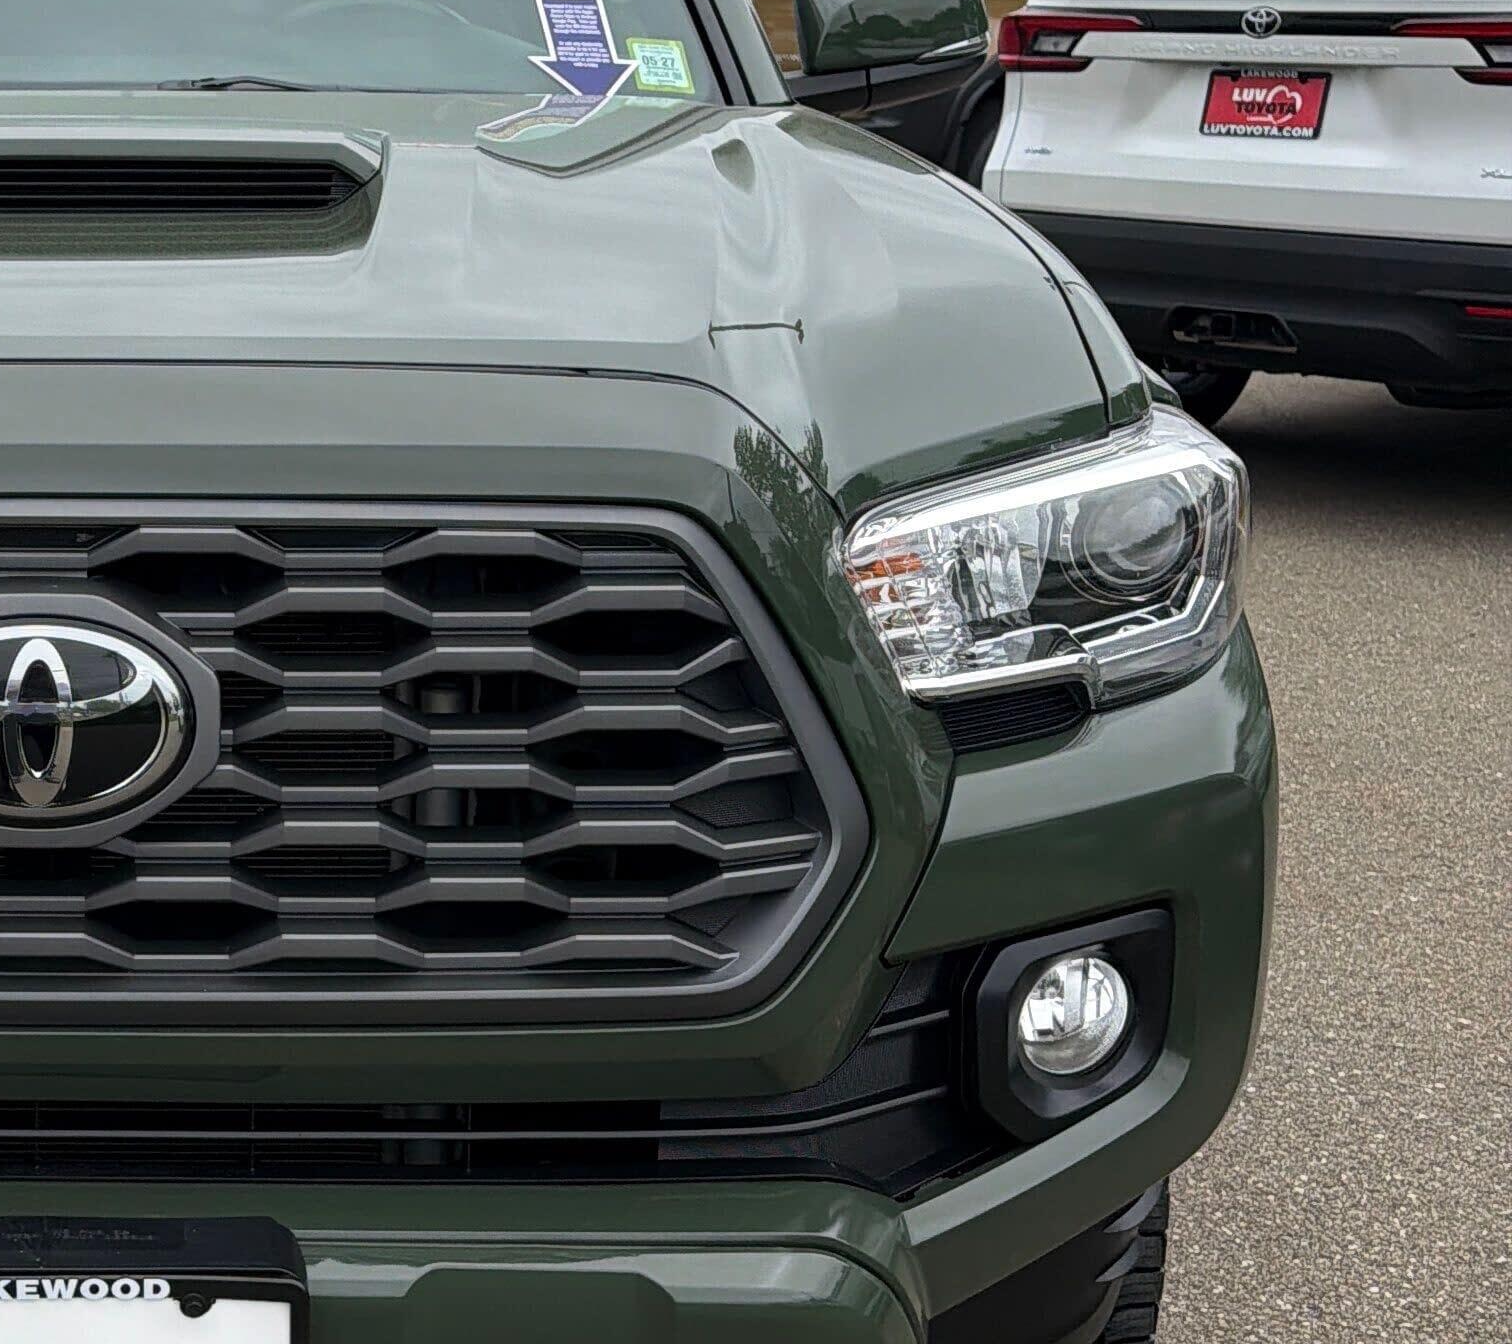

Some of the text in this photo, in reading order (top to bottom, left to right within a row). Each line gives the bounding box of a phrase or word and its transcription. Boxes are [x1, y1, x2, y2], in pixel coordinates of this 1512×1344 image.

[1240, 69, 1299, 79] LAKEWOOD
[1231, 87, 1269, 102] LUV
[1236, 102, 1298, 116] TOYOTA
[1203, 124, 1314, 138] LUVTOYOTA.COM
